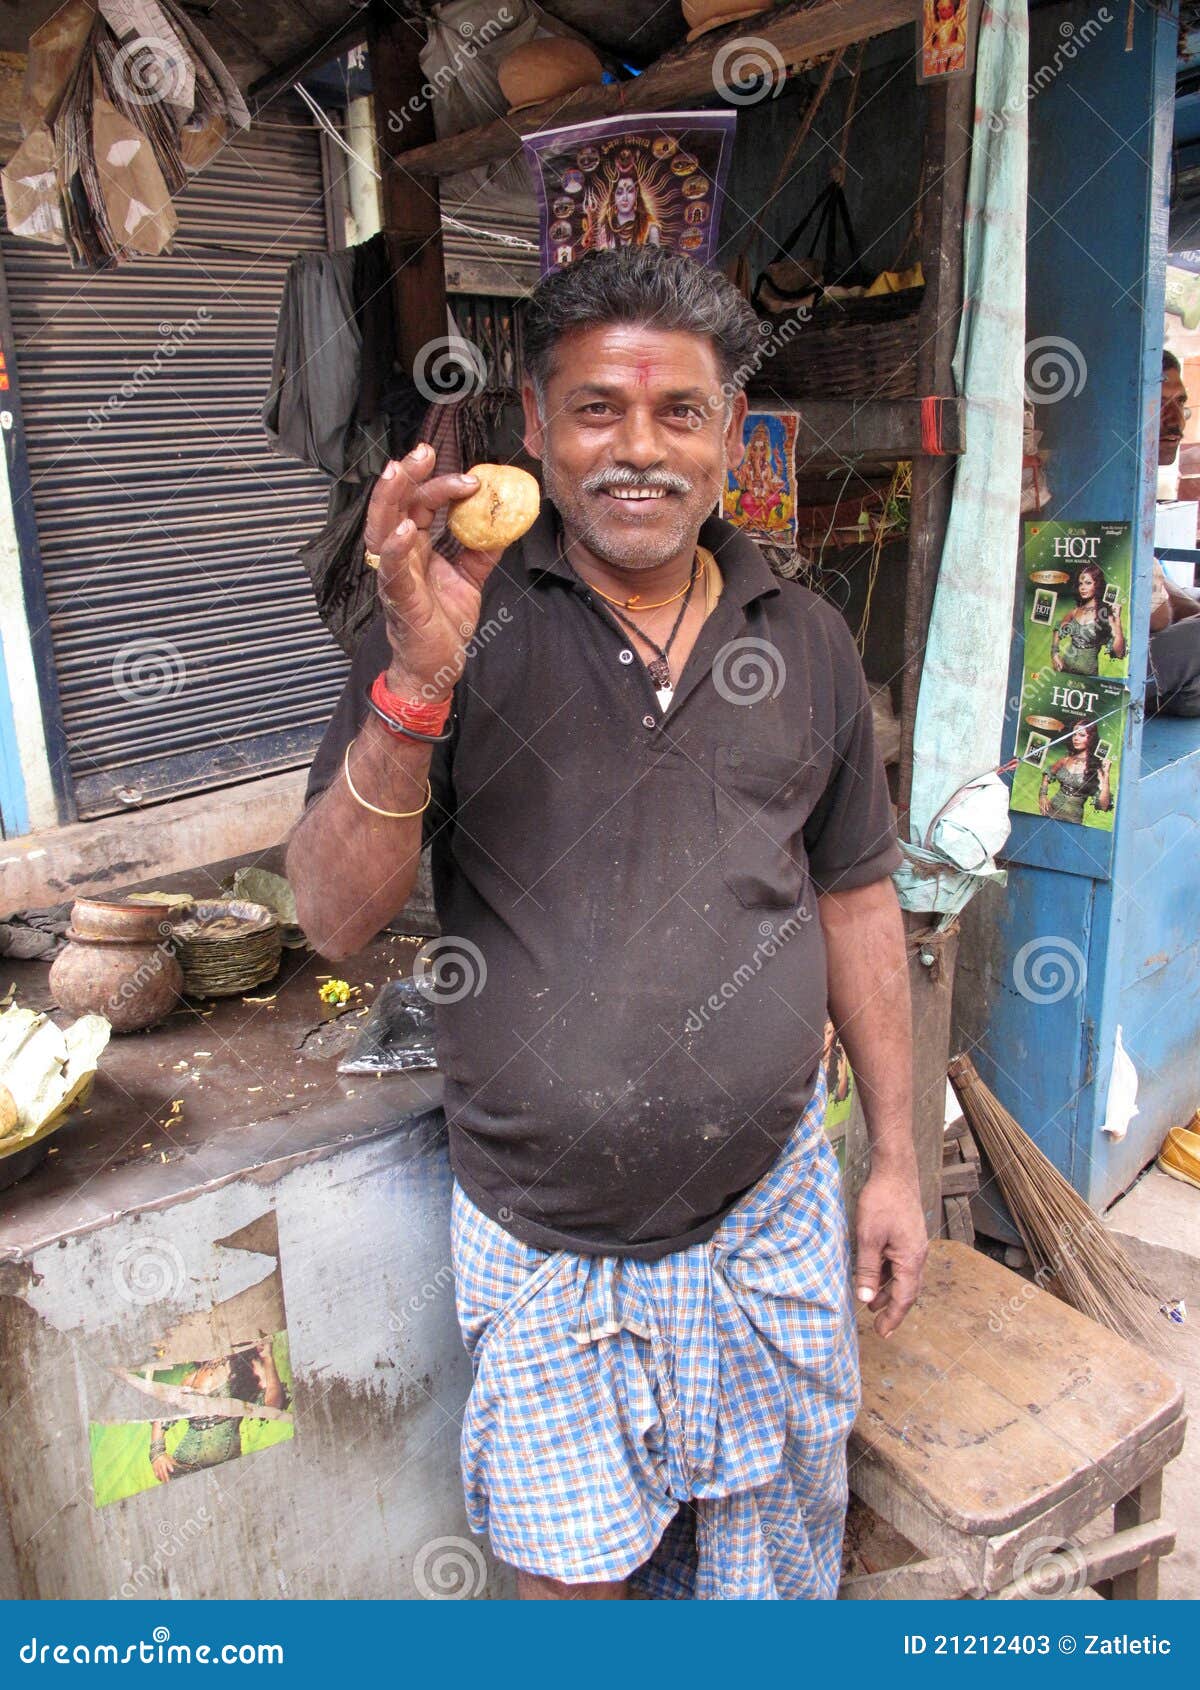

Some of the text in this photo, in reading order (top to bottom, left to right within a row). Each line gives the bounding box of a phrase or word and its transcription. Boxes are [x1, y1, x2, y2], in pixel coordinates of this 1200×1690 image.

[1053, 537, 1101, 558] HOT
[1036, 604, 1052, 615] HOT
[1050, 686, 1099, 713] HOT
